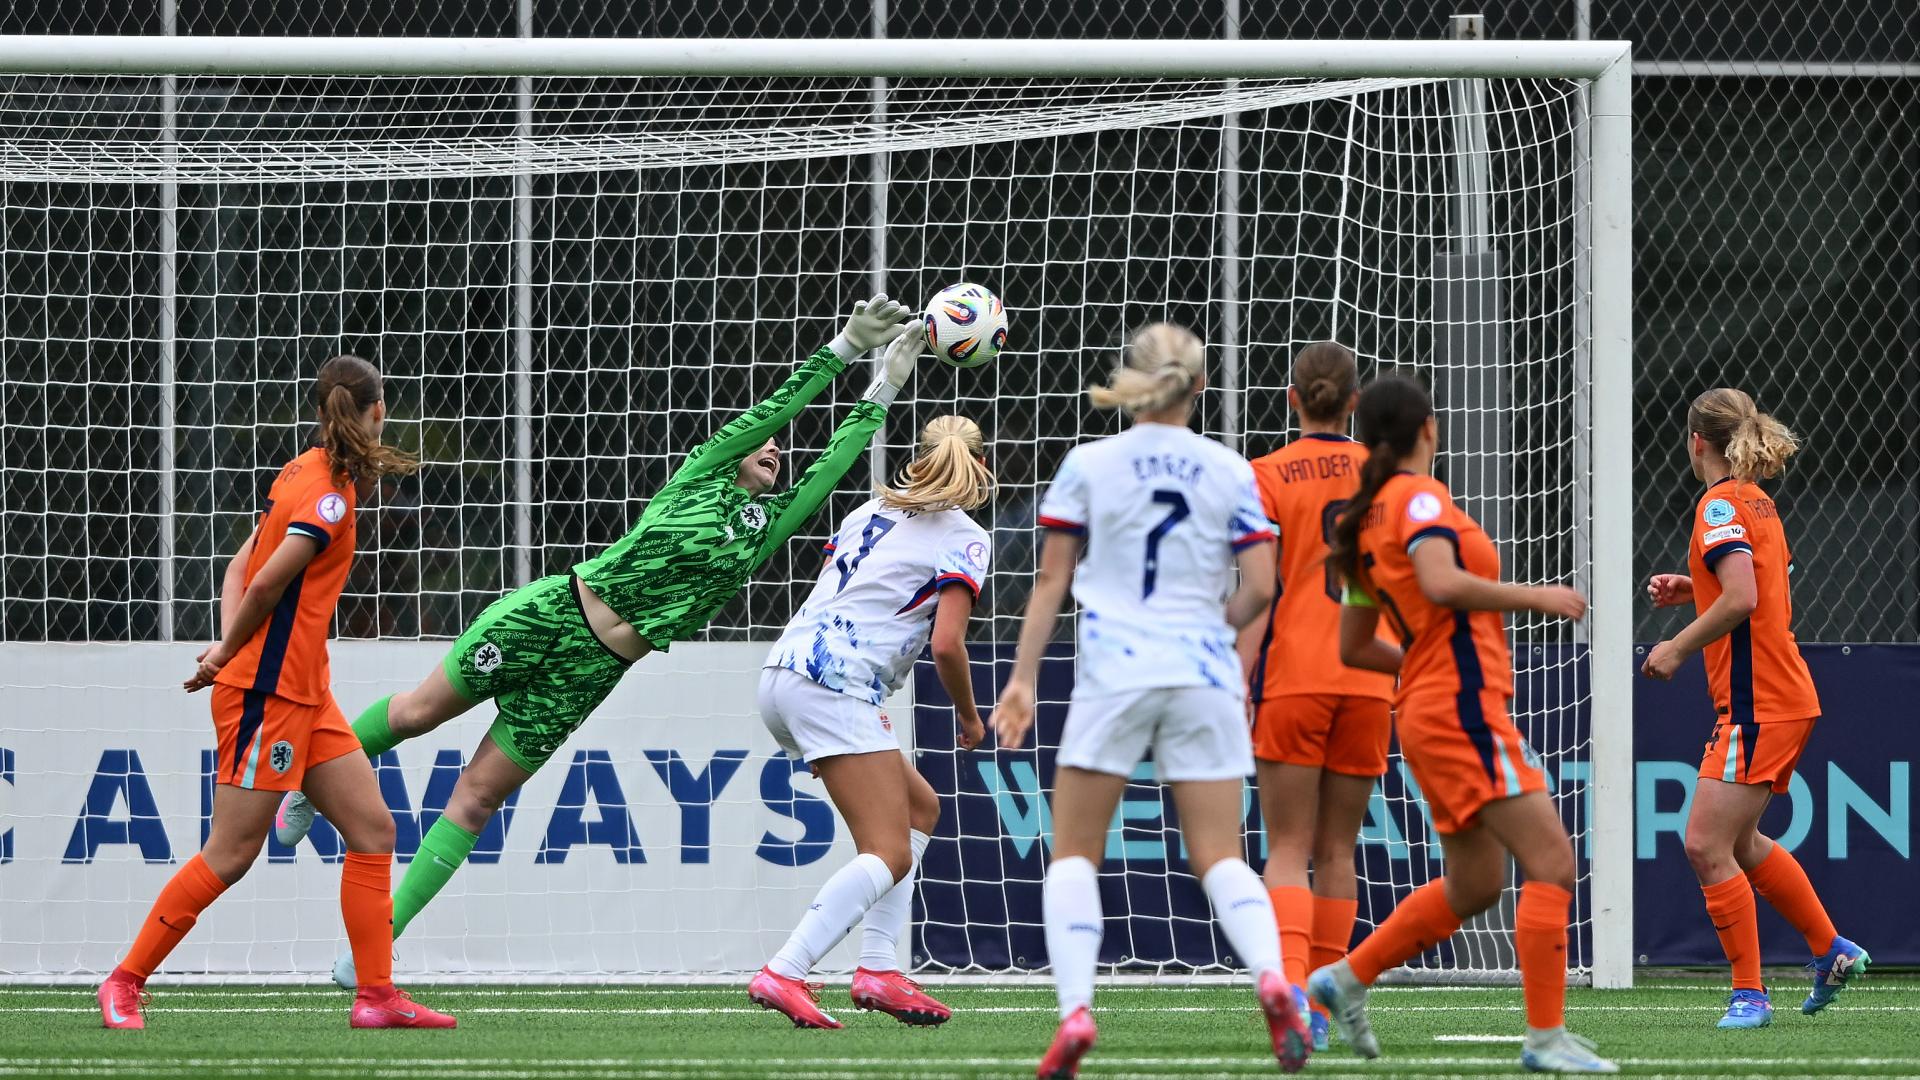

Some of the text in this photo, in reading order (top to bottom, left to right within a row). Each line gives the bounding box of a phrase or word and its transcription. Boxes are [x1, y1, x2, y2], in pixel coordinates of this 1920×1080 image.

[1276, 458, 1316, 484] VAN
[1317, 453, 1353, 480] DER
[1142, 489, 1191, 601] 7
[61, 748, 836, 867] AWAYS
